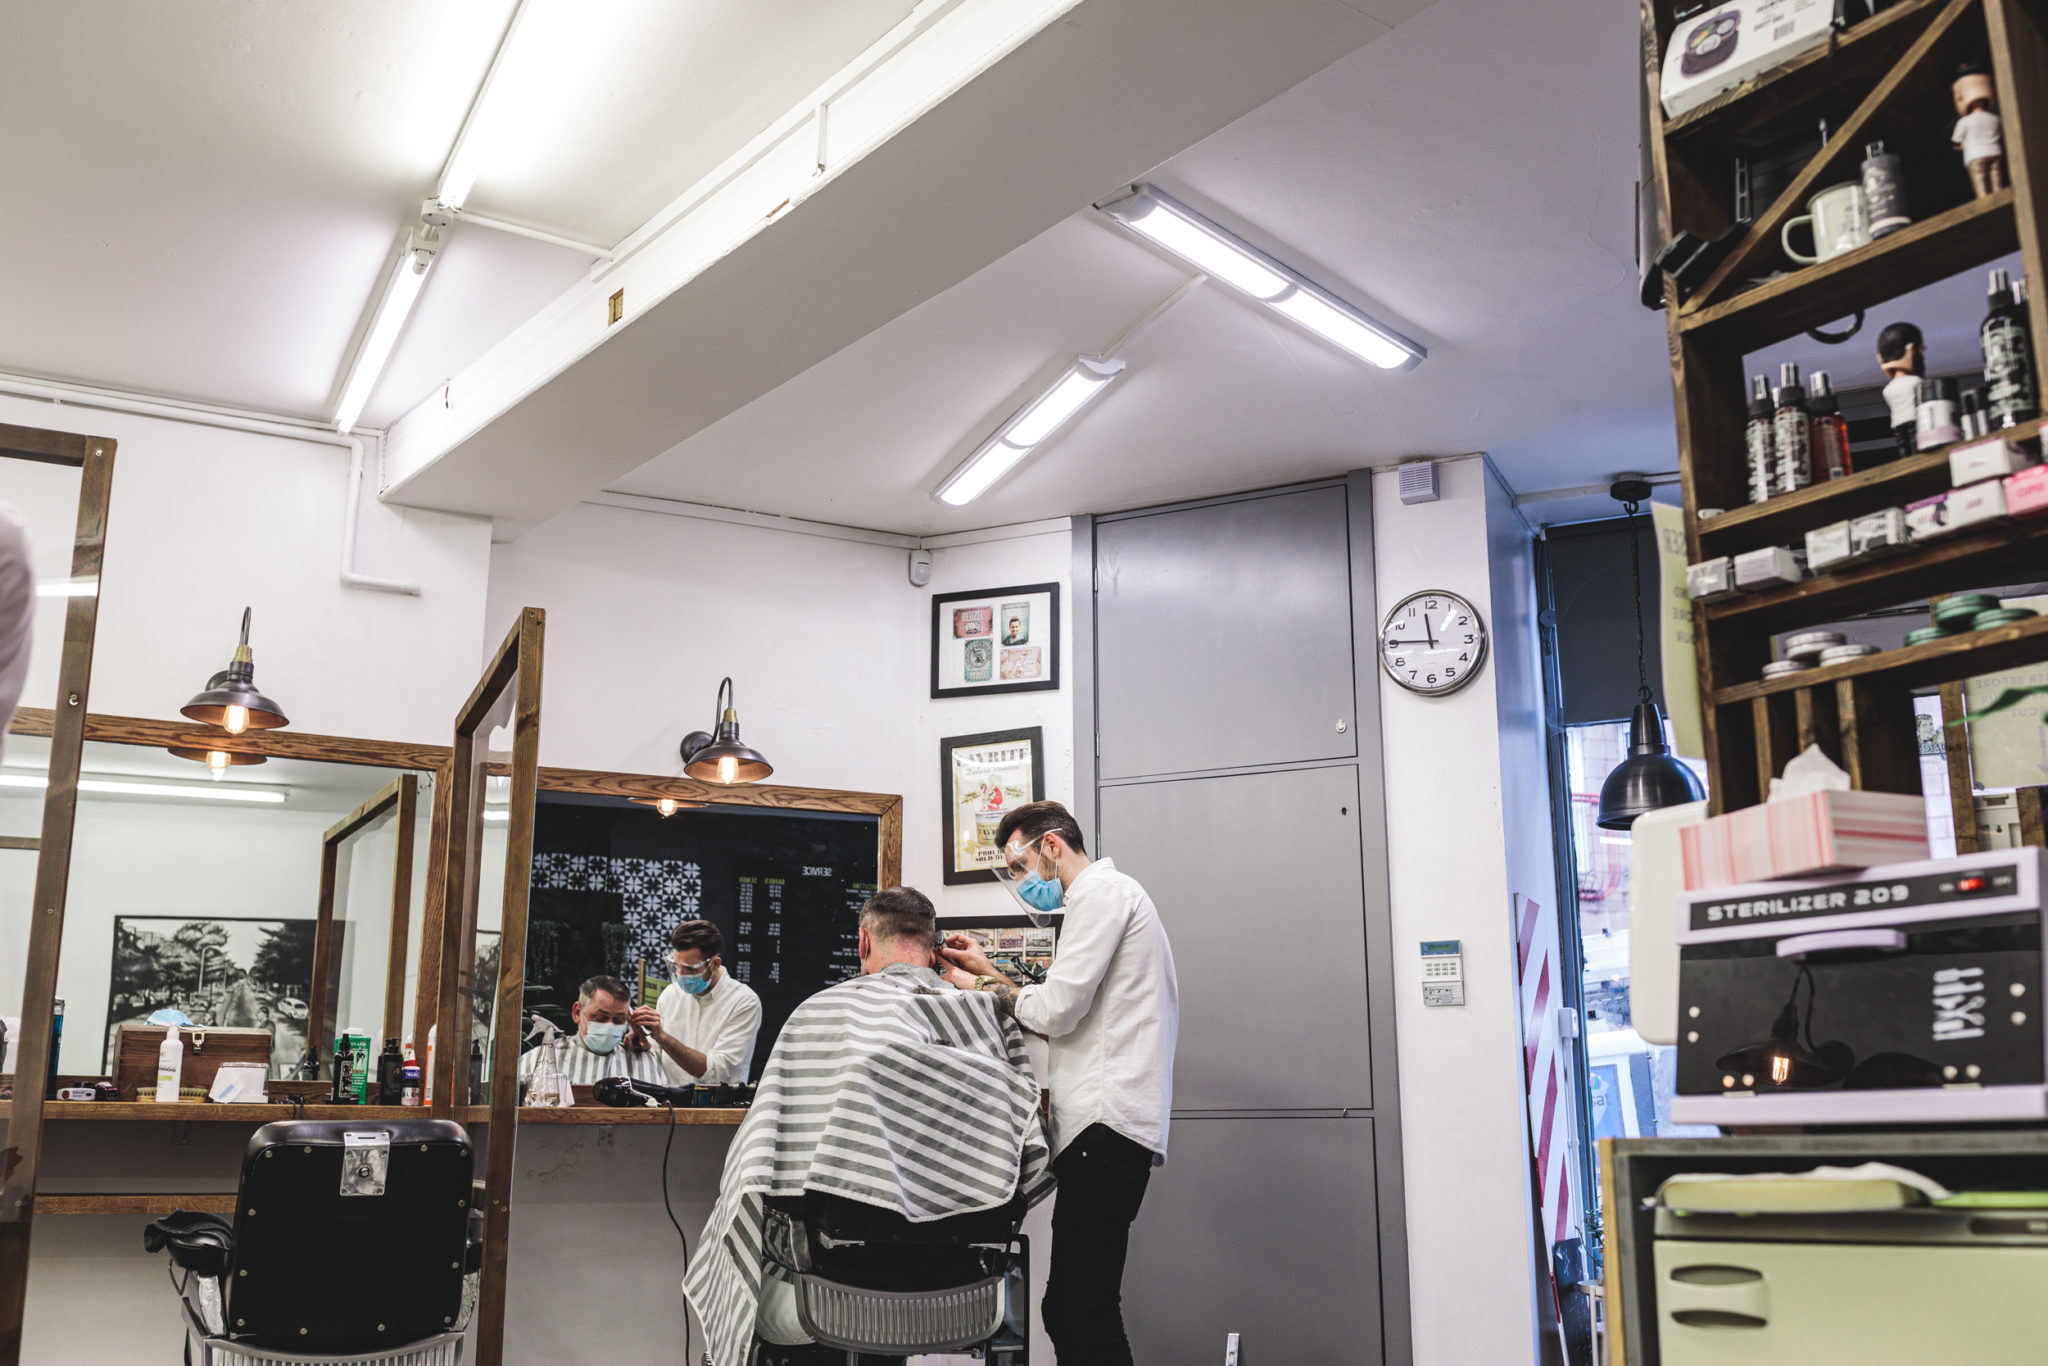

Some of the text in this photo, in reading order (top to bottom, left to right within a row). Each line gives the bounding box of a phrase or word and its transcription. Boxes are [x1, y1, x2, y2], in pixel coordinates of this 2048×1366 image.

[1425, 600, 1437, 610] 12
[1408, 608, 1416, 617] 11
[1458, 617, 1468, 625] 2
[1464, 634, 1474, 644] 3
[1459, 653, 1468, 662] 4
[1395, 658, 1405, 667] 8
[1408, 670, 1418, 680] 7
[1445, 668, 1456, 677] 5
[1426, 674, 1437, 684] 6
[1706, 885, 1911, 922] STERILIZER 209
